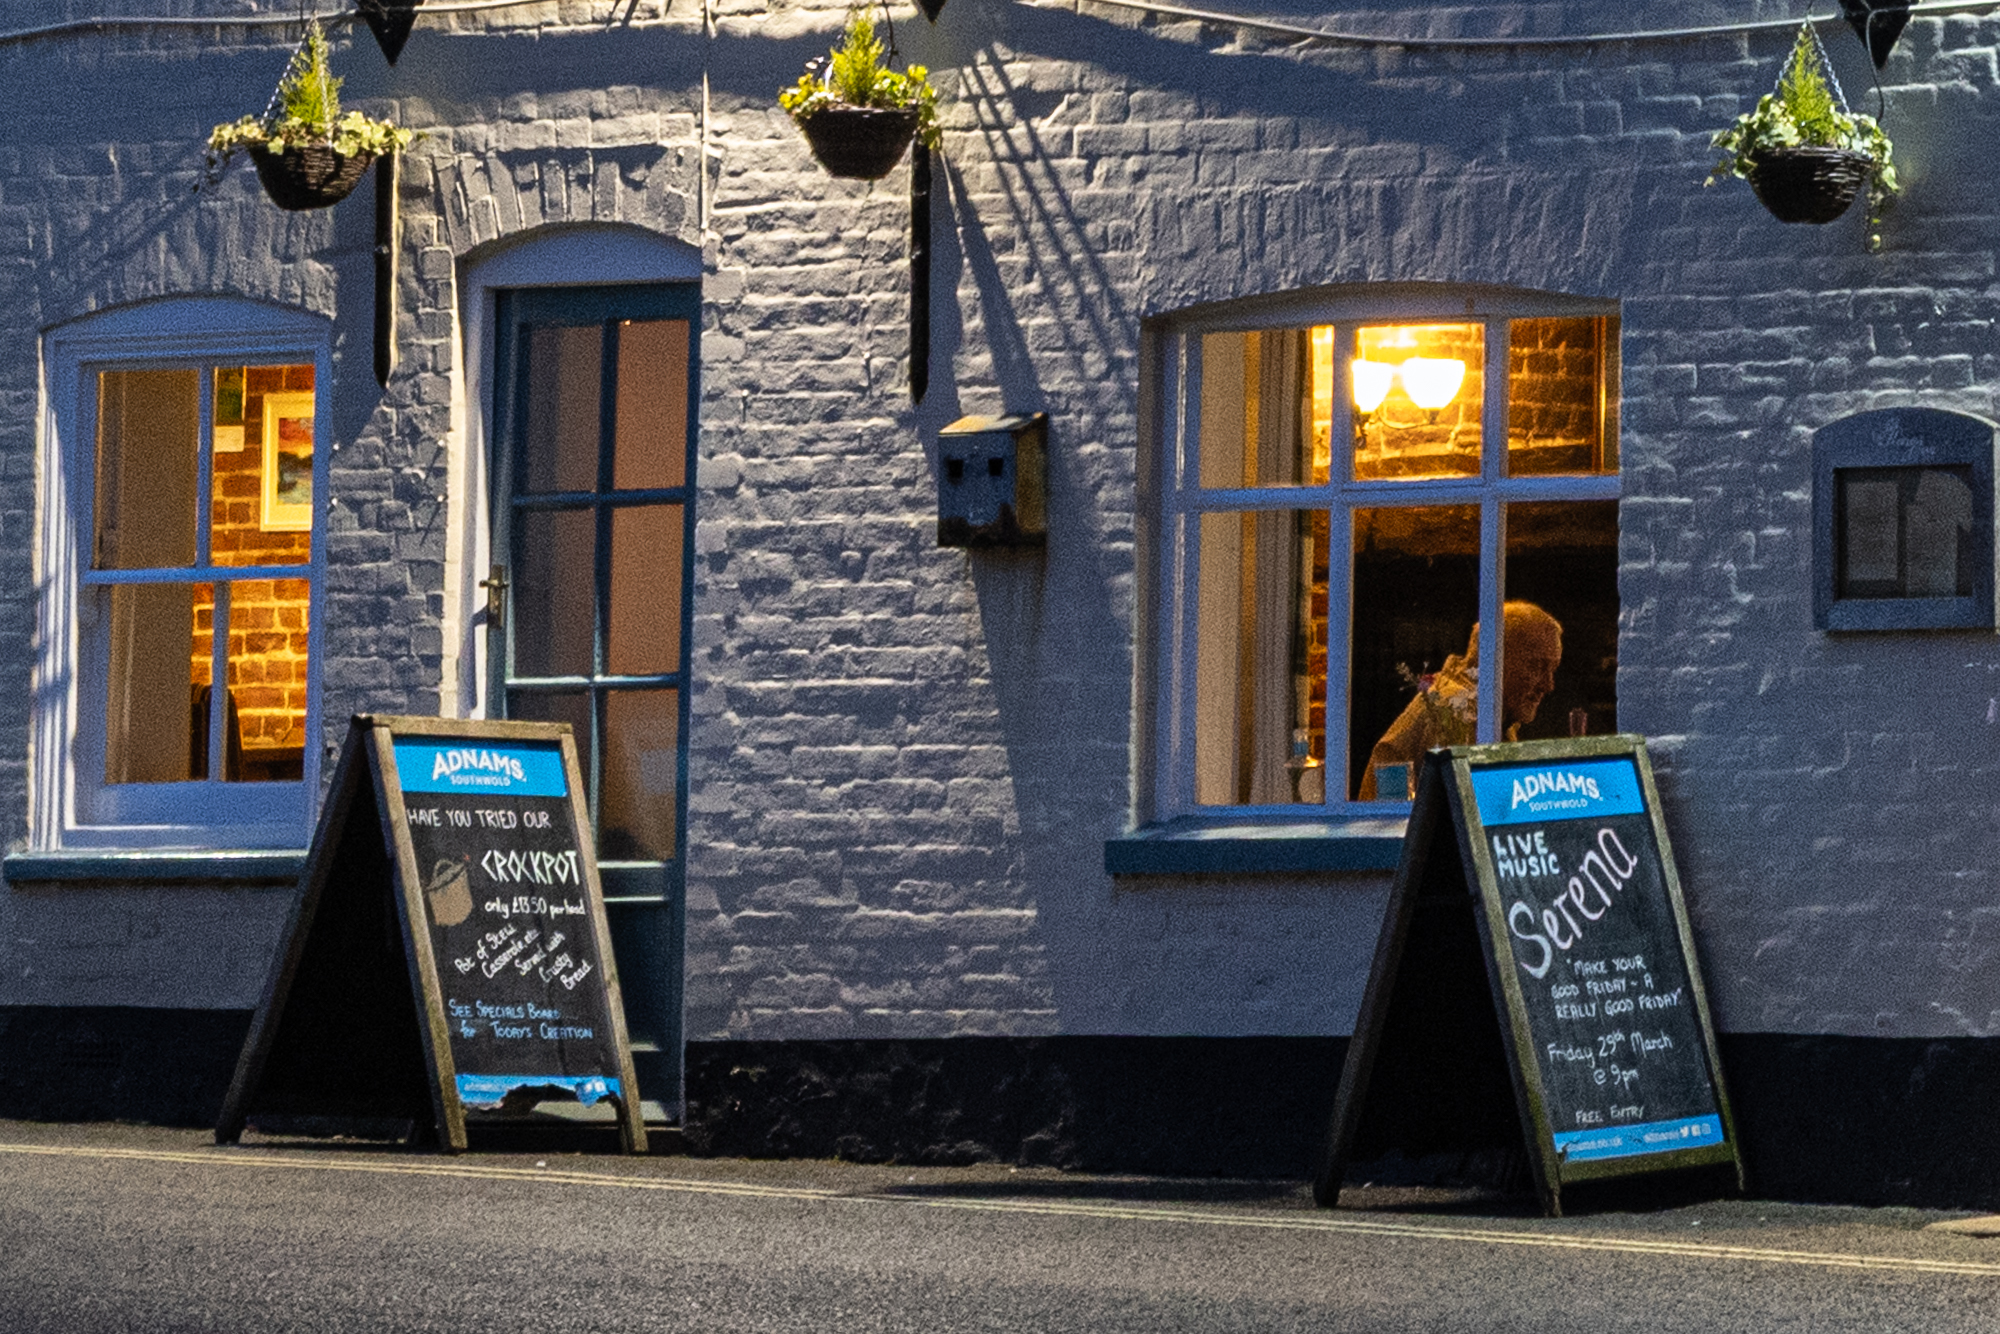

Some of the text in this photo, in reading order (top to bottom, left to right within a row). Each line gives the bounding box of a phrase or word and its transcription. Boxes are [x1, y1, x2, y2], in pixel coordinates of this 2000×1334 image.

[432, 749, 525, 781] ADNAMS
[450, 775, 511, 787] SOUTHWOLD
[1512, 771, 1602, 810] ADNAMS
[407, 808, 552, 829] HAVE YOU TRIED OUR
[1529, 799, 1588, 812] SOUTHWOLD
[1493, 831, 1548, 859] LIVE
[481, 850, 580, 885] CROCKPOT
[1498, 853, 1560, 878] MUSIC
[485, 896, 509, 918] only
[549, 904, 565, 920] per
[564, 898, 586, 916] head
[1509, 828, 1638, 979] Serena
[454, 957, 476, 975] Pot
[477, 939, 490, 960] of
[515, 930, 566, 976] Served with
[1613, 955, 1646, 972] YOUR
[538, 952, 573, 983] Crusty
[560, 959, 594, 991] Bread
[1551, 984, 1580, 999] GOOD
[1586, 978, 1628, 997] FRIDAY
[1644, 973, 1654, 990] A
[449, 998, 474, 1018] SEE
[476, 1000, 525, 1020] SPECIALS
[1555, 1003, 1596, 1020] REALLY
[1604, 999, 1634, 1017] GOOD
[540, 1022, 593, 1039] CREATION
[1547, 1029, 1673, 1069] Friday 29th March
[1611, 1064, 1639, 1090] 9pm
[1575, 1104, 1645, 1124] FREE ENTRY
